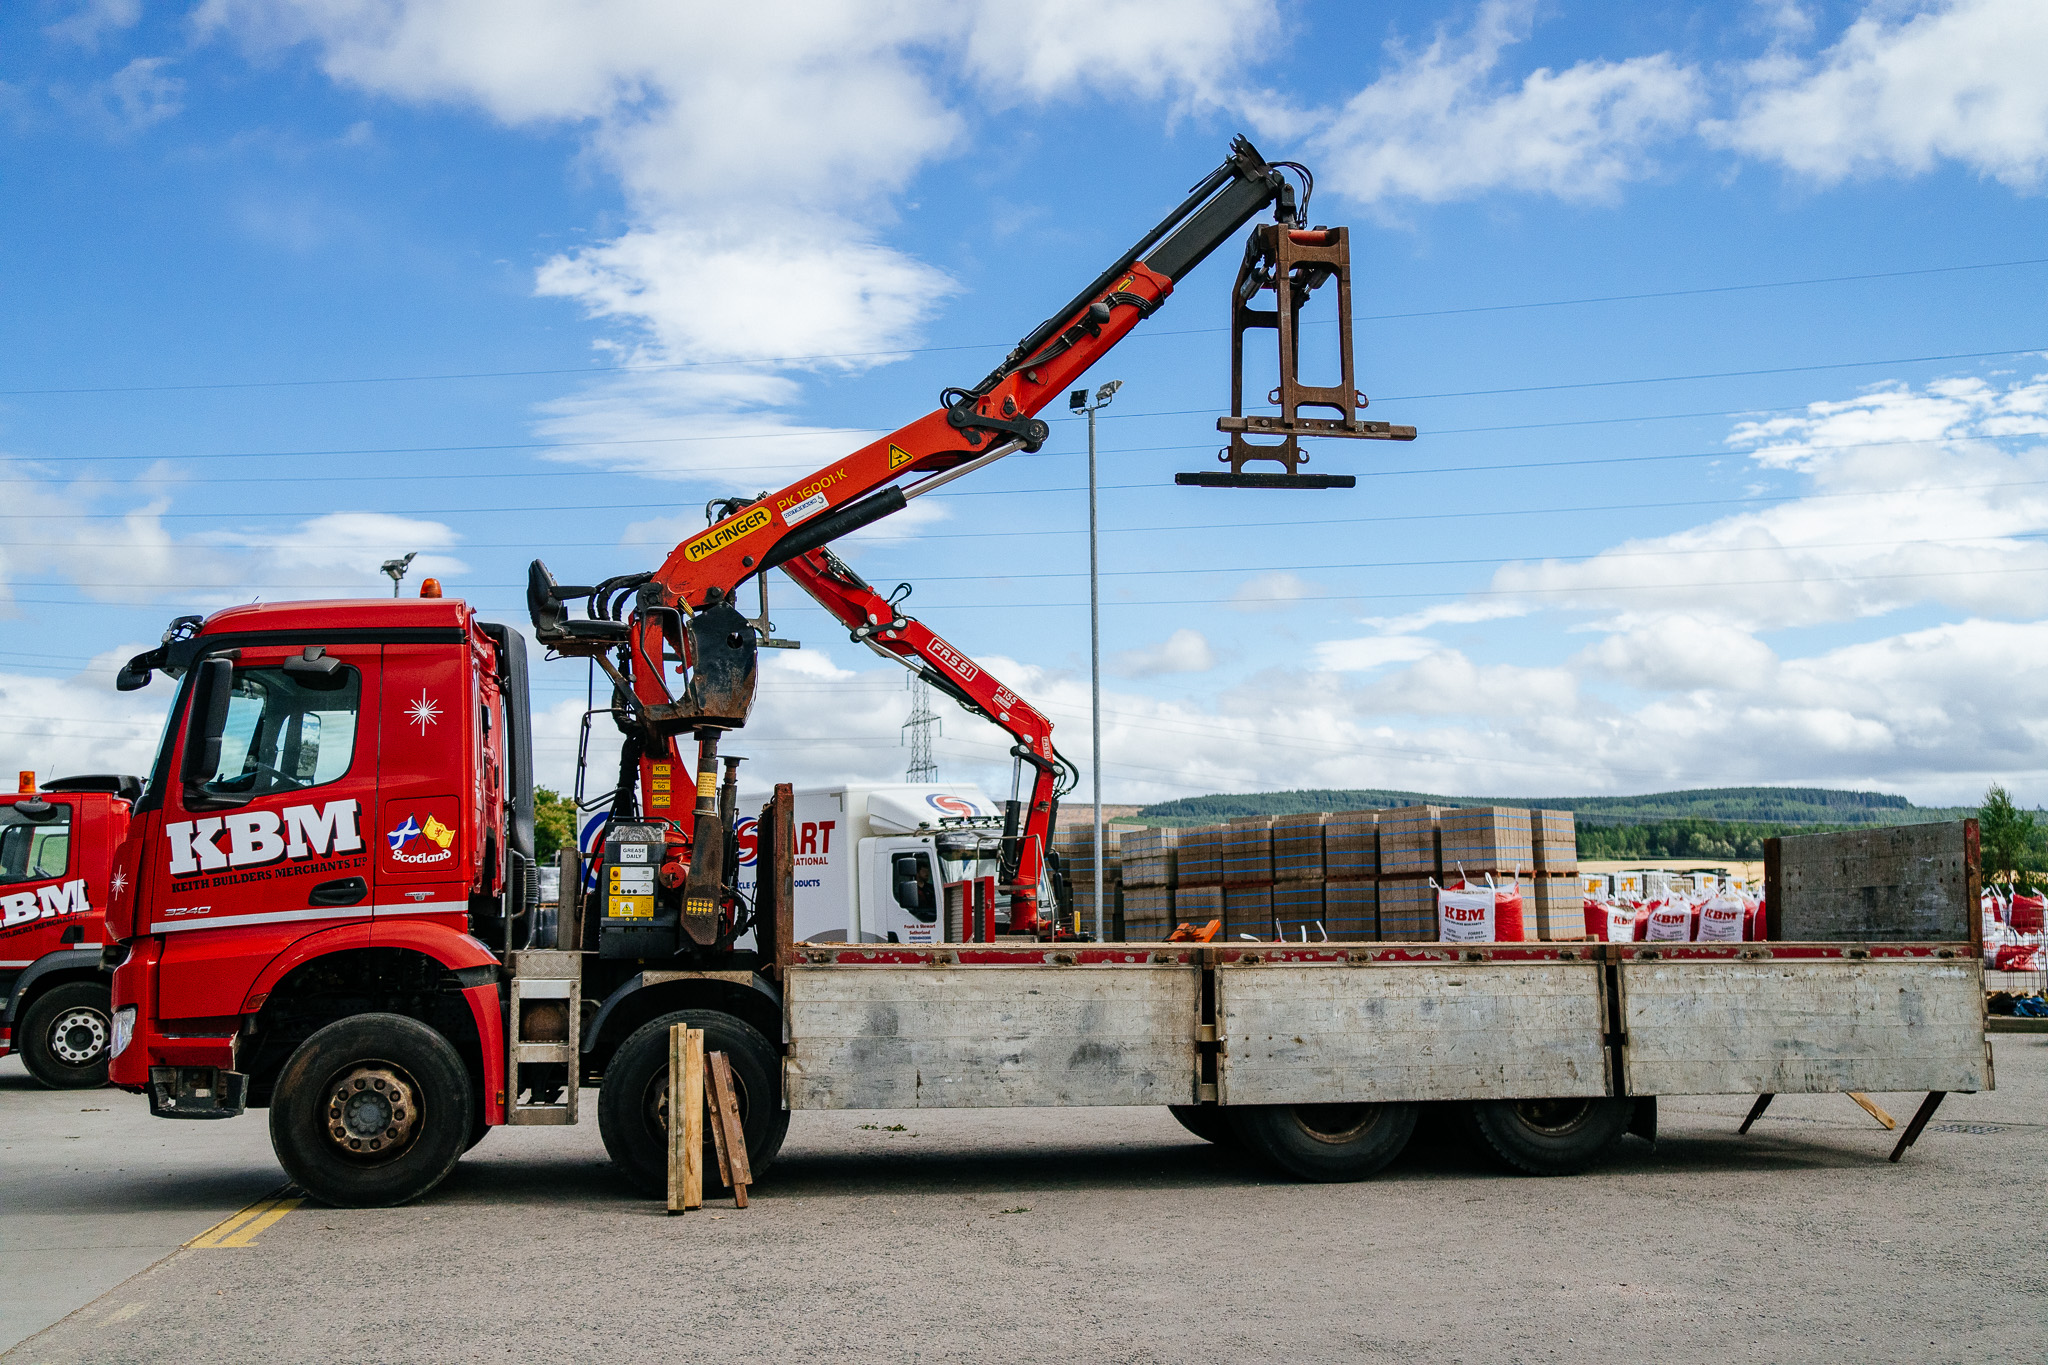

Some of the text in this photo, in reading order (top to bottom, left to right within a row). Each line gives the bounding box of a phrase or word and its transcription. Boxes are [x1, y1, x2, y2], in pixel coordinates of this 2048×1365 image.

[777, 496, 798, 512] PK
[689, 510, 767, 559] PALFINGER
[932, 642, 973, 677] FASSI
[996, 685, 1018, 705] F155
[166, 798, 362, 875] KBM
[392, 849, 452, 864] Scotland
[171, 878, 210, 893] KEITH
[212, 870, 272, 888] BUILDERS
[274, 860, 350, 878] MERCHANTS
[0, 878, 91, 928] BM
[1445, 905, 1485, 921] KBM
[1653, 912, 1685, 924] KBM
[1704, 908, 1737, 920] KBM
